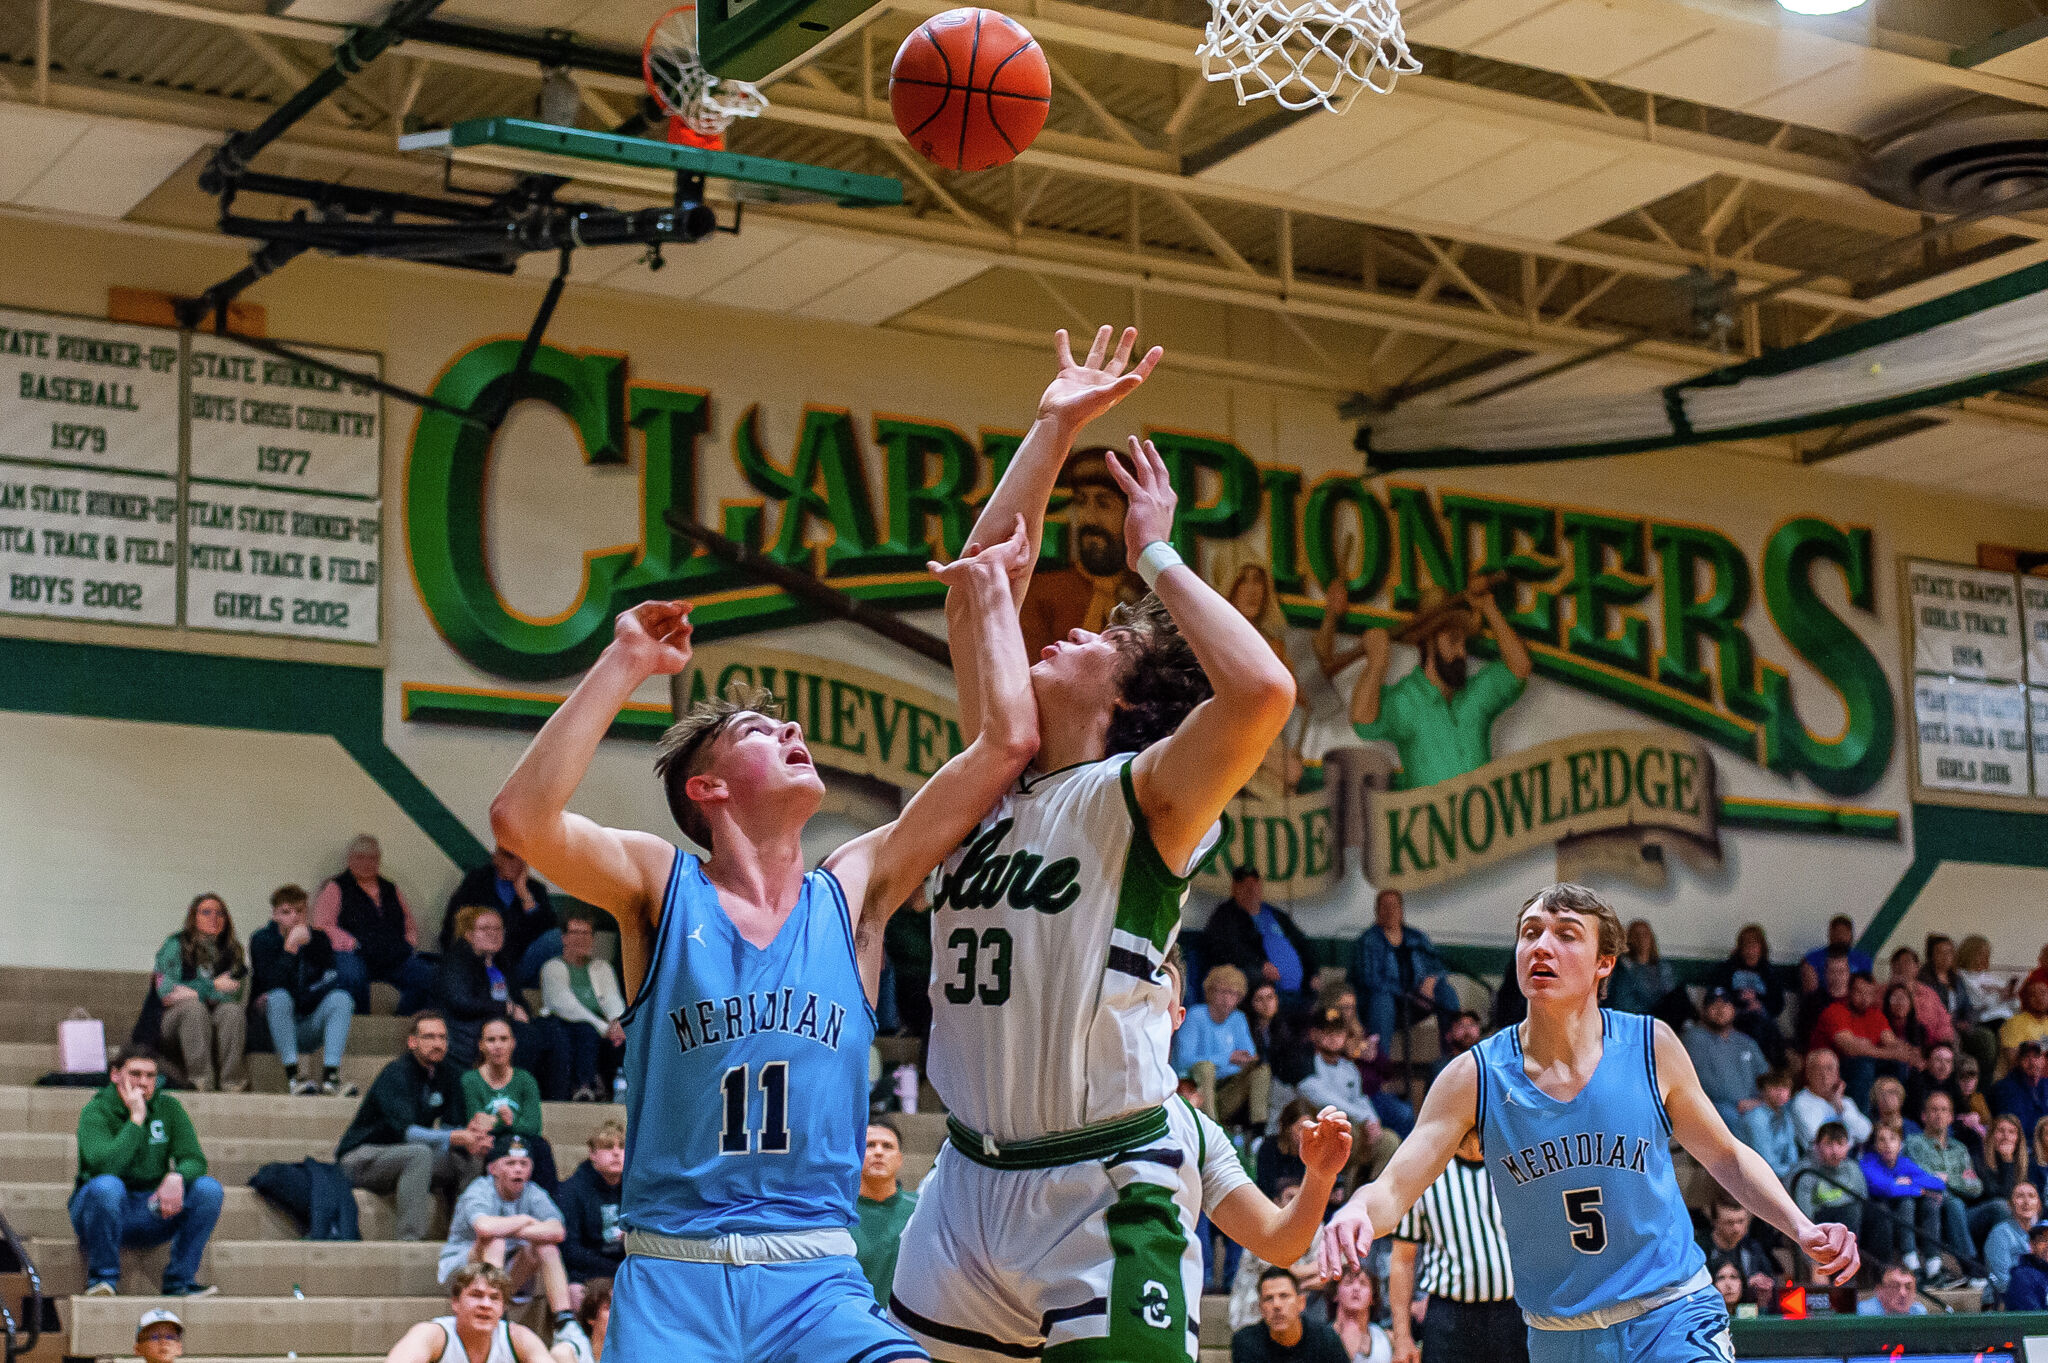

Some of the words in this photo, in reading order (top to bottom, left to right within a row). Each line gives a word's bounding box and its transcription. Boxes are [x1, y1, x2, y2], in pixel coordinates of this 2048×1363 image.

[57, 334, 177, 373] RUNNER-UP
[191, 352, 255, 382] STATE
[20, 371, 139, 411] BASEBALL
[193, 393, 236, 423] BOYS
[241, 399, 292, 428] CROSS
[297, 406, 375, 438] COUNTRY
[51, 421, 107, 453] 1979
[257, 445, 312, 475] 1977
[31, 485, 82, 515] STATE
[86, 490, 177, 524] RUNNER-UP
[189, 501, 233, 529] TEAM
[238, 506, 286, 534] STATE
[292, 511, 377, 544] RUNNER-UP
[42, 529, 100, 561] TRACK
[124, 537, 176, 567] FIELD
[249, 549, 304, 579] TRACK
[328, 557, 377, 586] FIELD
[10, 574, 74, 605] BOYS
[82, 579, 143, 611] 2002
[214, 592, 283, 622] GIRLS
[292, 599, 350, 628] 2002
[1386, 748, 1700, 875] KNOWLEDGE
[945, 928, 1013, 1006] 33
[669, 986, 847, 1054] MERIDIAN
[719, 1060, 791, 1156] 11
[1500, 1131, 1652, 1187] MERIDIAN
[1561, 1186, 1609, 1255] 5
